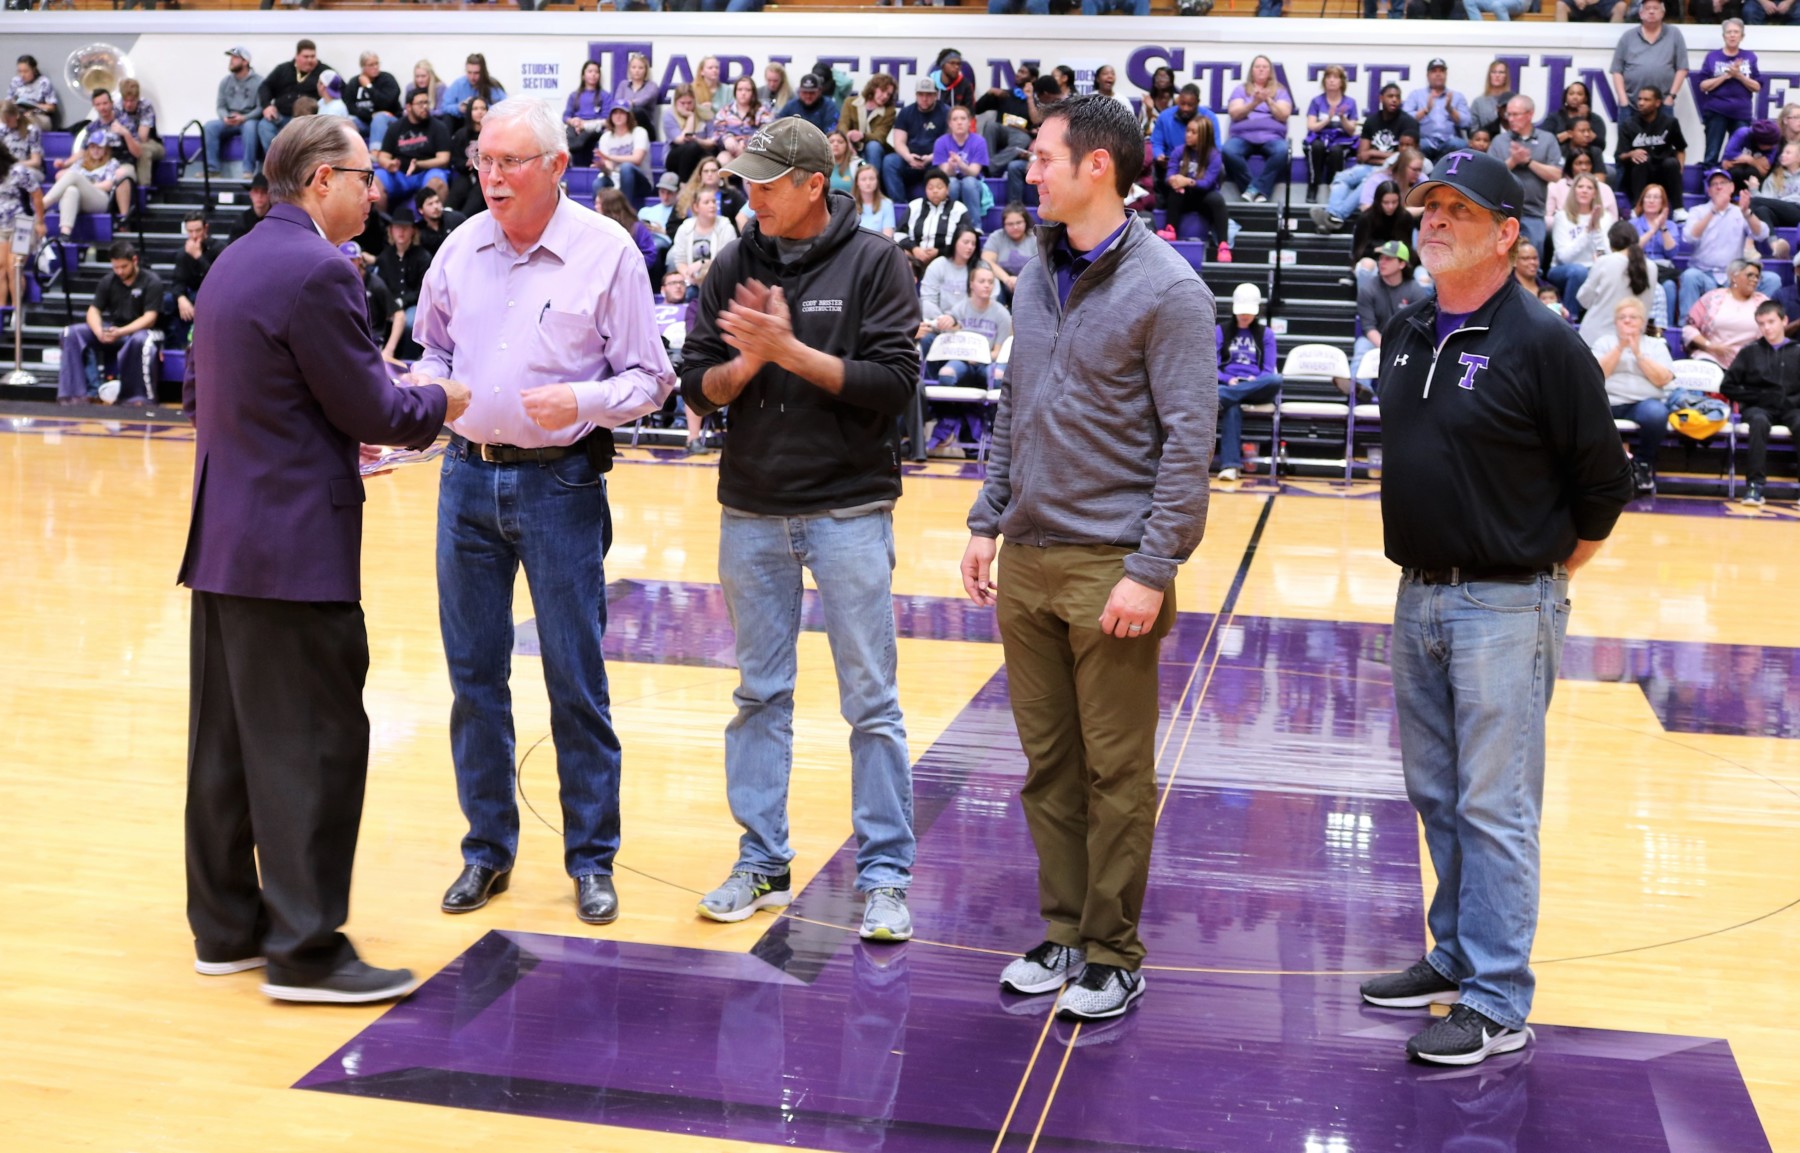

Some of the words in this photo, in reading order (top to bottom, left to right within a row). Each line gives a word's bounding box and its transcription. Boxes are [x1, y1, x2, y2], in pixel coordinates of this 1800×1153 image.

[521, 63, 559, 75] STUDENT
[588, 41, 1041, 108] TARTN
[1074, 70, 1096, 82] UDEN
[522, 77, 558, 89] SECTION
[1446, 152, 1474, 175] T
[1458, 351, 1490, 390] T
